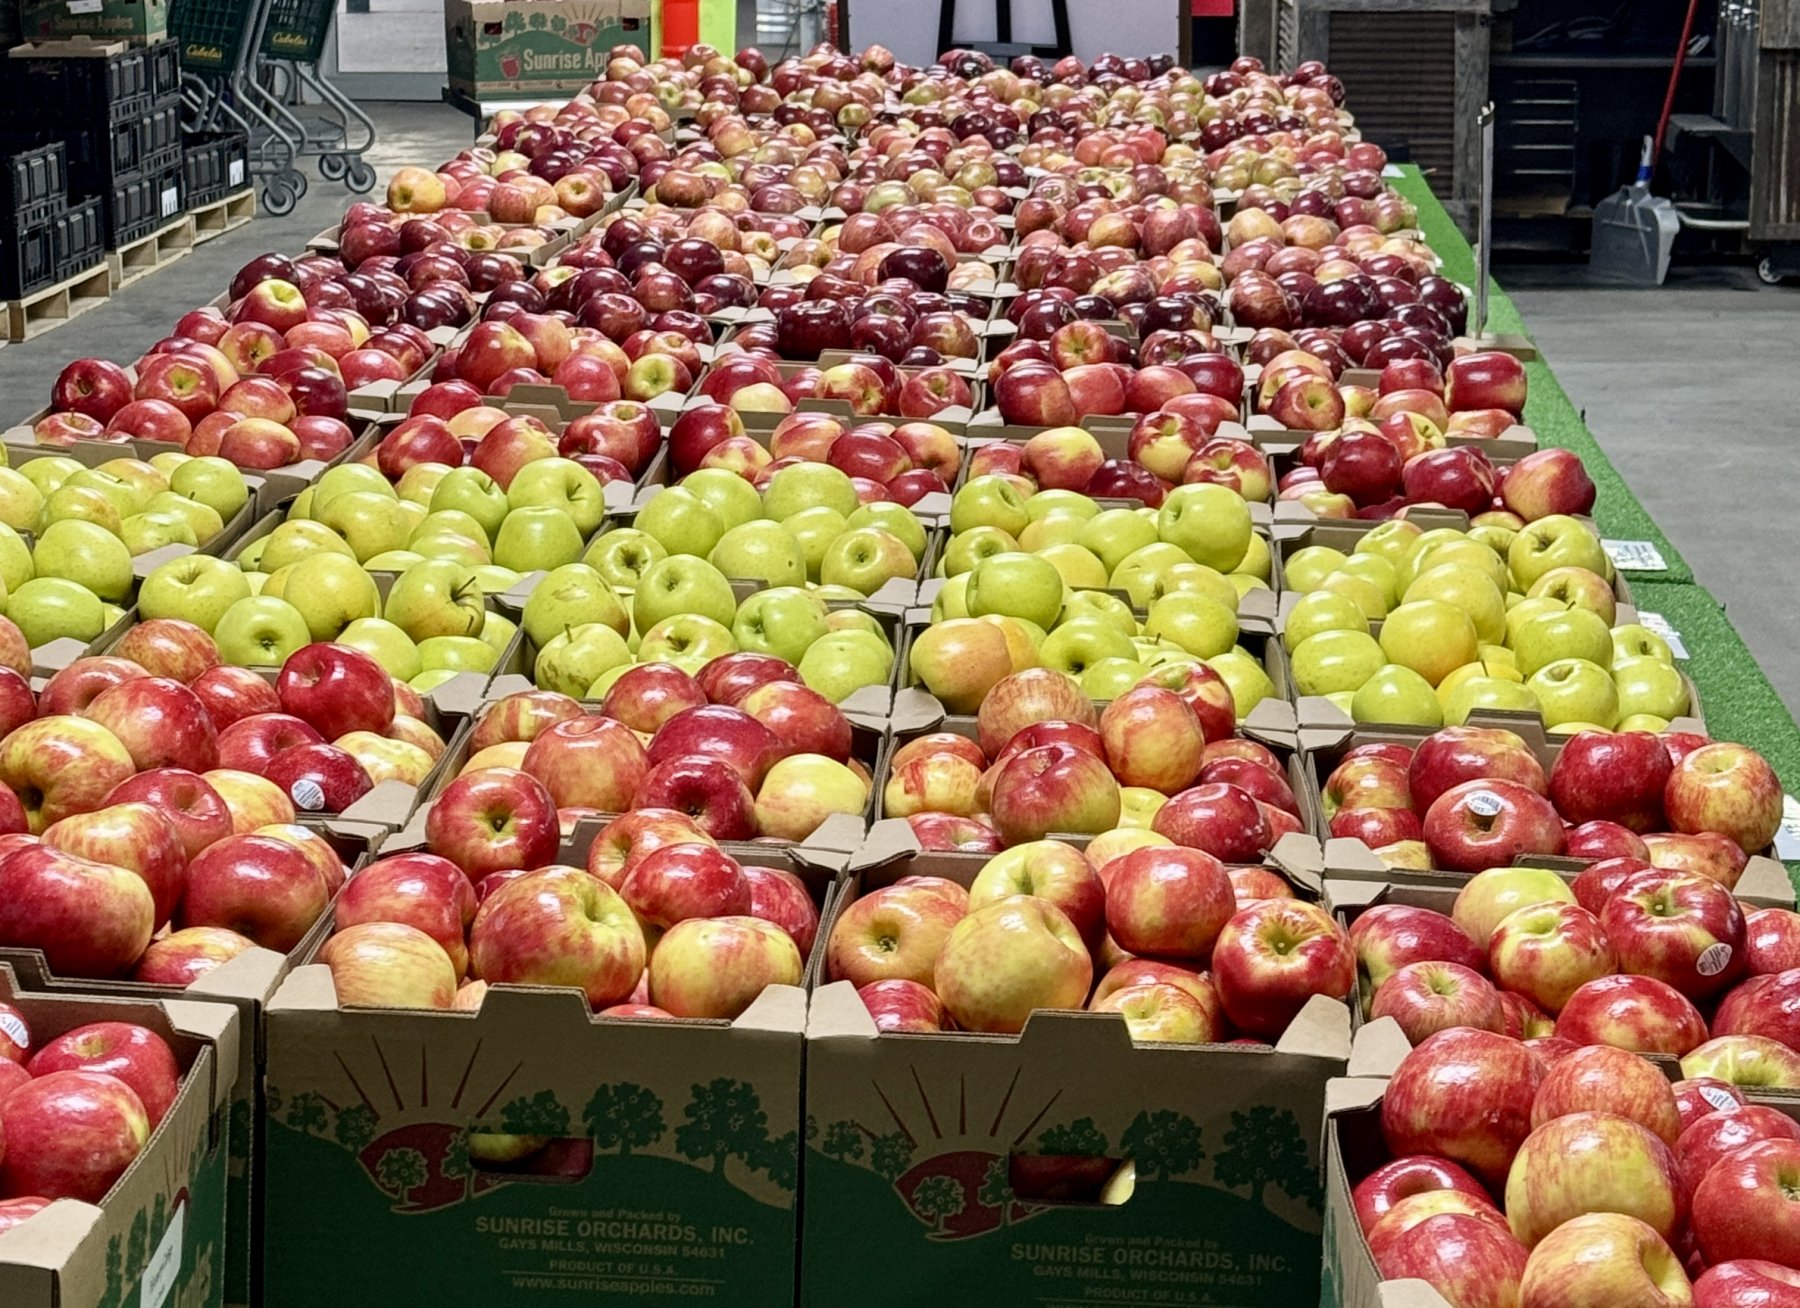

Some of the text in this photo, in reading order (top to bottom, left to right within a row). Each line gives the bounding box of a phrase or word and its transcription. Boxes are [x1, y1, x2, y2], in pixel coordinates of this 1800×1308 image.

[524, 47, 611, 73] Sunrise App
[549, 1206, 681, 1223] Grown and Packed by
[475, 1215, 754, 1244] SUNRISE ORCHARDS, INC.
[498, 1237, 725, 1258] GAYS MILLS, WISCONSIN 54631
[1010, 1243, 1292, 1273] SUNRISE ORCHARDS, INC.
[549, 1259, 612, 1273] PRODUCT
[617, 1263, 635, 1274] OF
[1032, 1264, 1073, 1278] GAYS
[1076, 1266, 1126, 1281] MILLS,
[1130, 1269, 1214, 1285] WISCONSIN
[511, 1275, 715, 1296] www.sunriseapples.com
[1085, 1286, 1148, 1300] PRODUCT
[1152, 1290, 1171, 1301] OF
